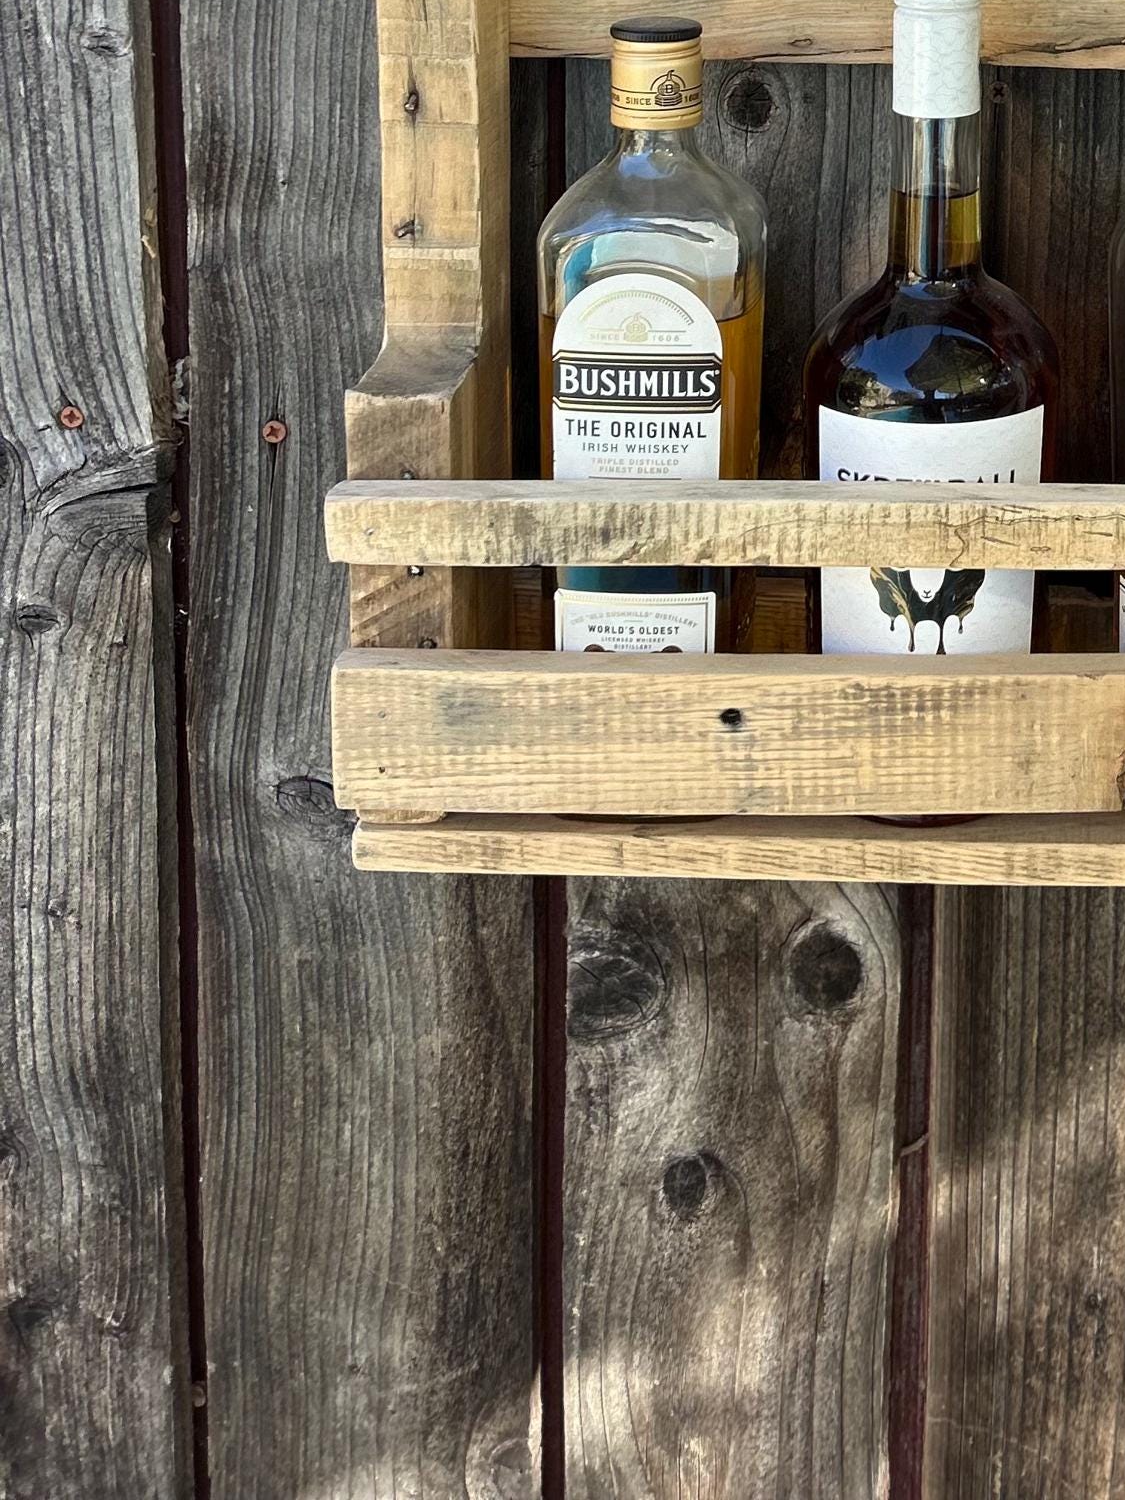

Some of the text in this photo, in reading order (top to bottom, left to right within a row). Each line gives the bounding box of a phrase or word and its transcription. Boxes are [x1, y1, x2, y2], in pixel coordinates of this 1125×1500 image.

[625, 96, 652, 106] SINCE
[589, 332, 620, 341] SINCE
[559, 364, 717, 398] BUSHMILLS
[565, 418, 707, 439] THE ORIGINAL
[582, 442, 689, 454] IRISH WHISKEY
[591, 457, 679, 466] TRIPLE DISTILLED
[599, 466, 670, 474] FINEST BLEND
[655, 612, 698, 629] DISTILLERY
[588, 625, 680, 635] WORLD'S OLDEST
